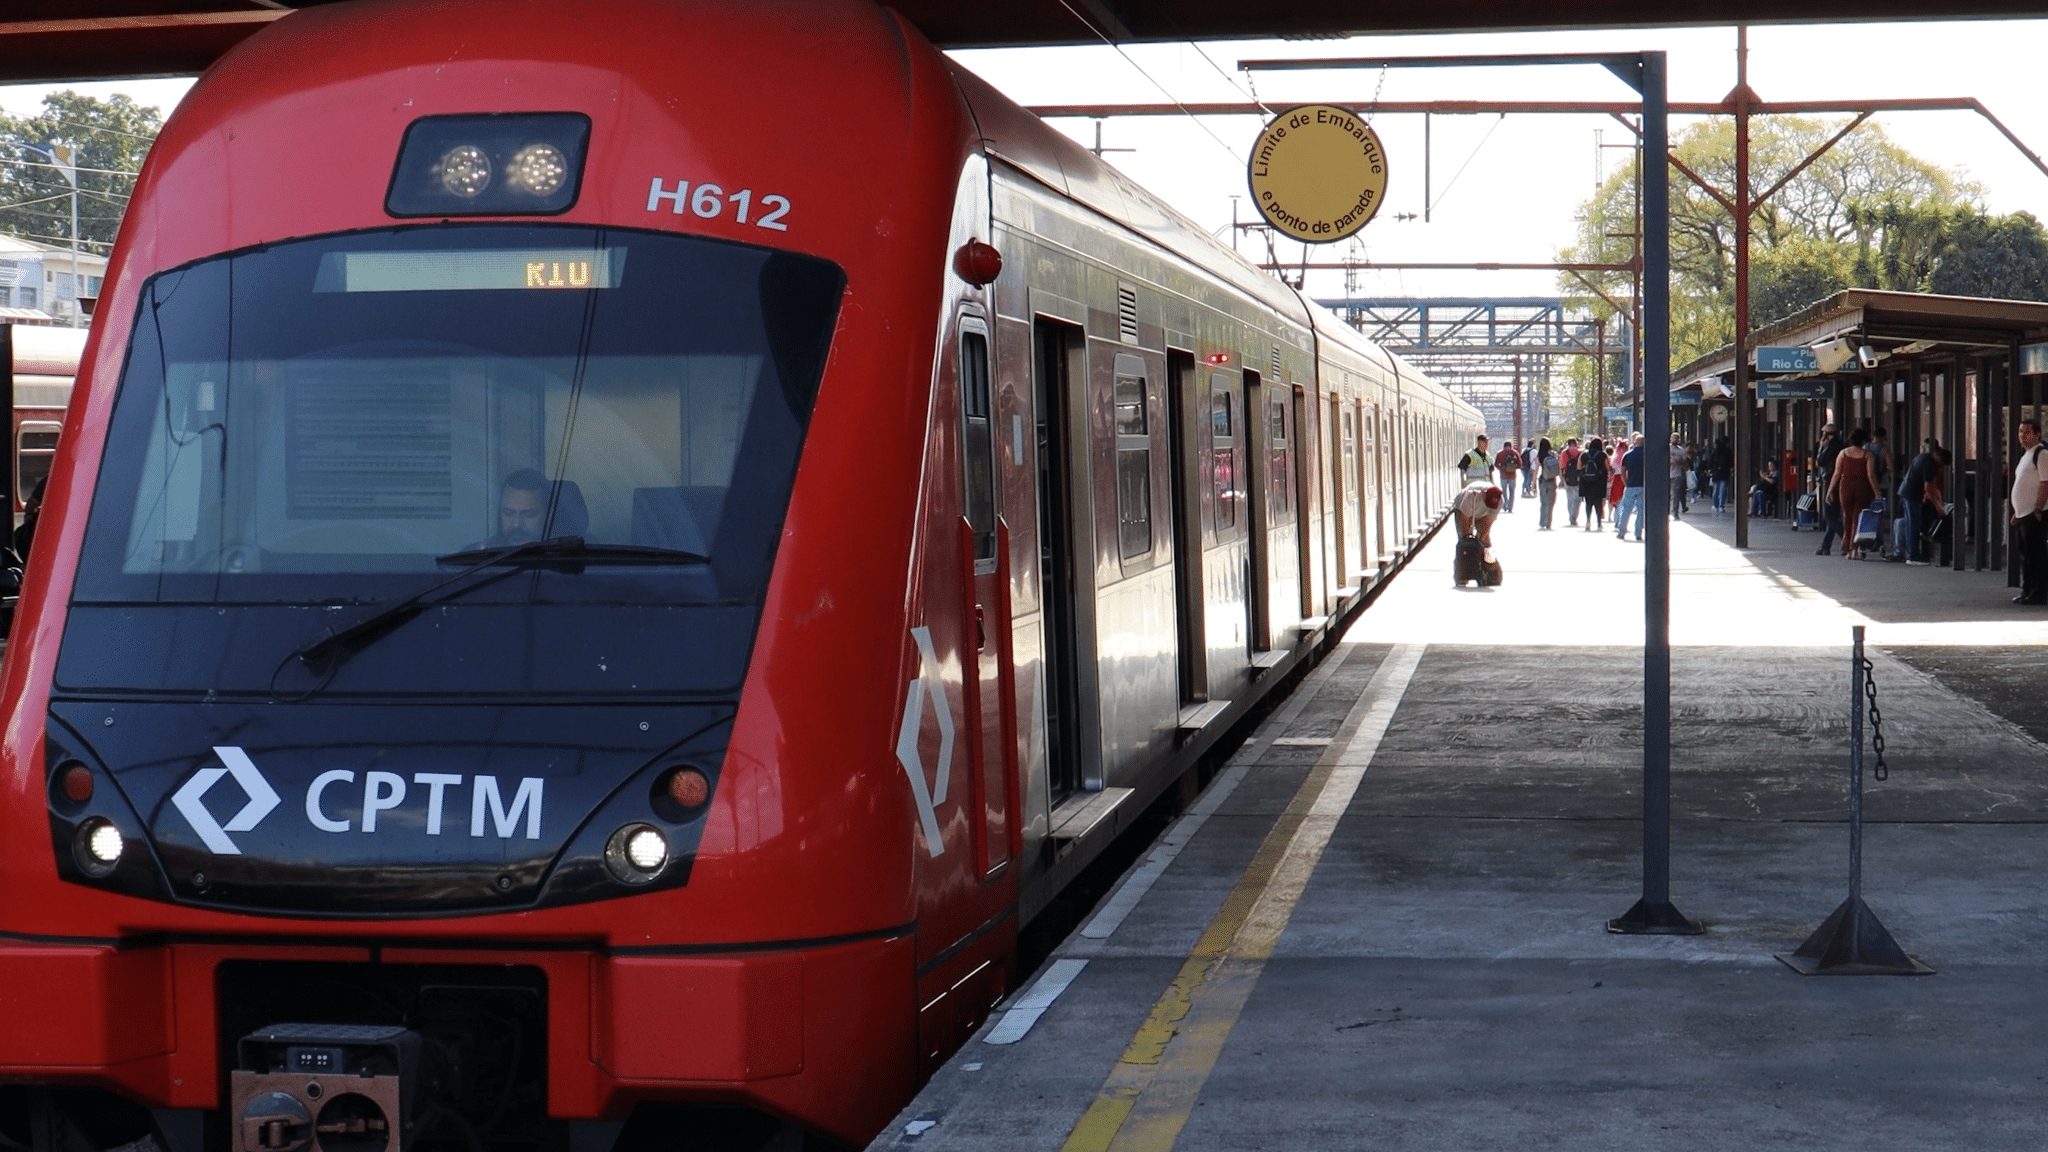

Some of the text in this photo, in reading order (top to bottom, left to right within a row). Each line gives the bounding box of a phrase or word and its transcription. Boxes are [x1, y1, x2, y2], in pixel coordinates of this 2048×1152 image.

[1254, 109, 1382, 177] Limite de Embarque
[646, 177, 791, 232] H612
[1262, 188, 1375, 234] e ponto de parada
[1772, 359, 1791, 369] Rio
[1794, 359, 1807, 369] G.
[305, 769, 545, 840] CPTM
